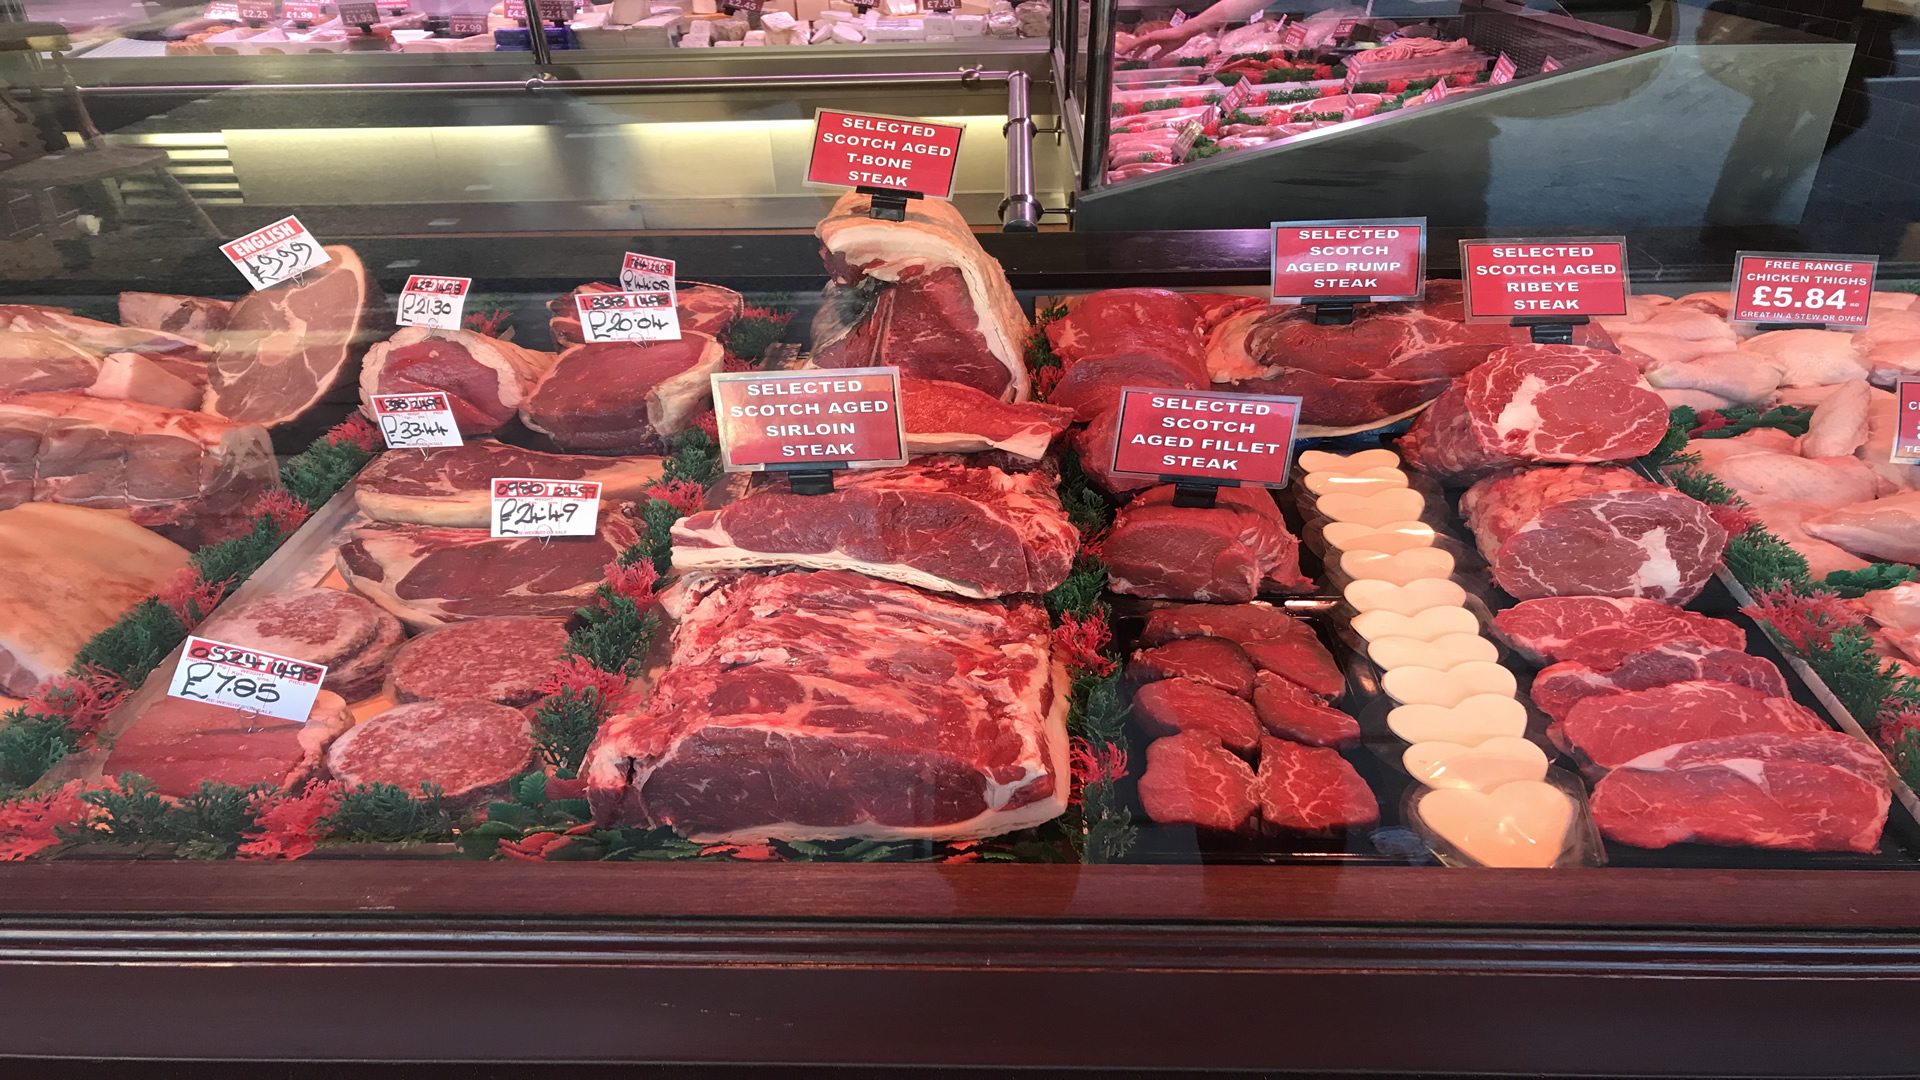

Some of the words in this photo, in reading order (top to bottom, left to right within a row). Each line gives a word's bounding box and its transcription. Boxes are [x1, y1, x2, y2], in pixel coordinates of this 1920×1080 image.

[242, 9, 269, 18] £2.25
[286, 11, 313, 19] £1.99
[345, 13, 374, 24] £1.99
[454, 23, 482, 33] £2.99
[842, 117, 936, 137] SELECTED
[822, 132, 896, 150] SCOTCH
[901, 142, 951, 157] AGED
[846, 152, 913, 170] T-BONE
[848, 170, 908, 187] STEAK
[231, 222, 297, 257] ENGLISH
[1298, 229, 1400, 240] SELECTED
[1309, 245, 1389, 256] SCOTCH
[1492, 247, 1594, 258] SELECTED
[1285, 262, 1339, 273] AGED
[1345, 262, 1401, 272] RUMP
[1475, 264, 1556, 276] SCOTCH
[1562, 264, 1617, 275] AGED
[1765, 260, 1801, 270] FREE
[1804, 262, 1853, 272] RANGE
[1313, 278, 1378, 288] STEAK
[1746, 273, 1810, 284] CHICKEN
[1814, 275, 1867, 286] THIGHS
[1506, 282, 1579, 293] RIBEYE
[1752, 285, 1847, 310] £5.84
[1513, 299, 1580, 310] STEAK
[1740, 310, 1771, 318] GREAT
[1773, 311, 1783, 319] IN
[1837, 314, 1863, 322] OVEN
[746, 380, 862, 396] SELECTED
[730, 403, 820, 418] SCOTCH
[828, 400, 889, 414] AGED
[1151, 396, 1271, 416] SELECTED
[765, 422, 855, 437] SIRLOIN
[1161, 416, 1256, 434] SCOTCH
[782, 443, 856, 457] STEAK
[1130, 433, 1194, 448] AGED
[1201, 438, 1280, 455] FILLET
[1162, 454, 1239, 471] STEAK
[180, 662, 281, 703] £7.85
